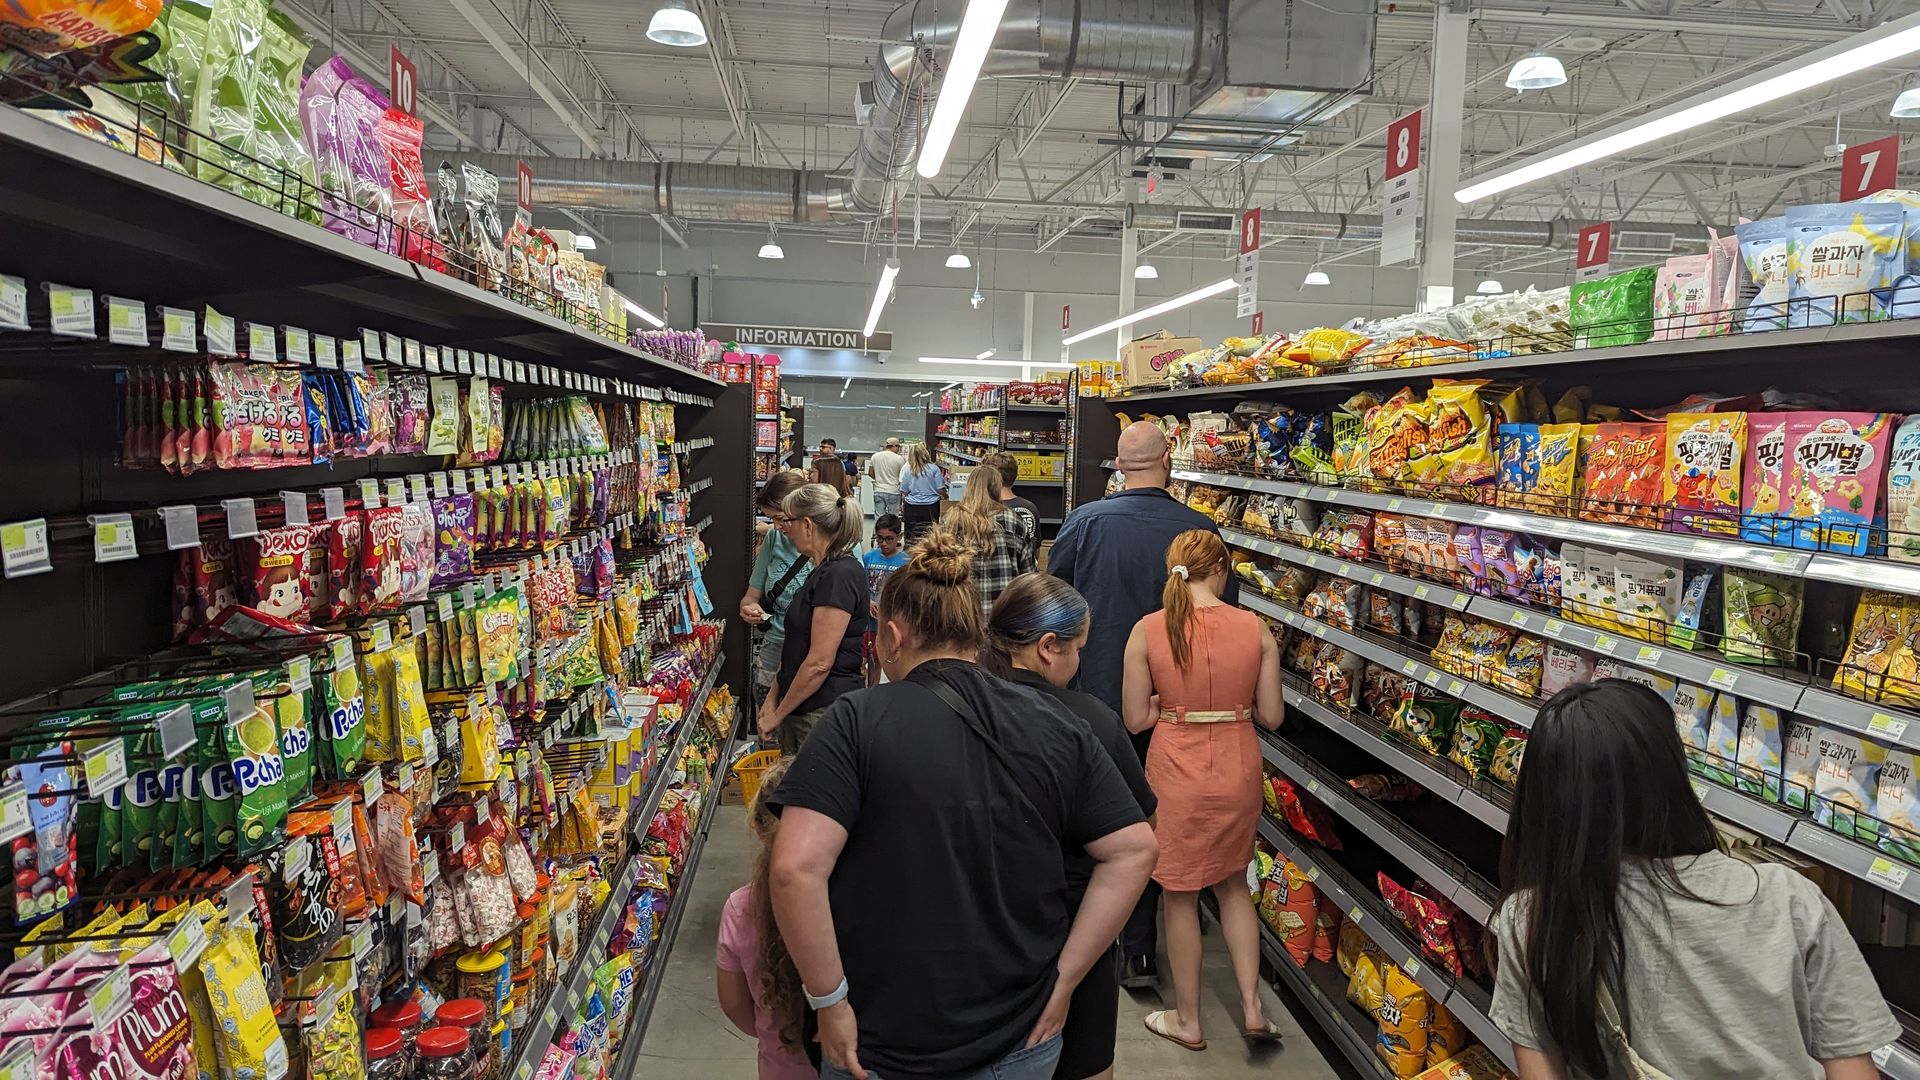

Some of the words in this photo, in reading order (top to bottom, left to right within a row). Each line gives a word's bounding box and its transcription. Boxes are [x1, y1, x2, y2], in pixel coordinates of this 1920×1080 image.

[396, 63, 412, 114] 10
[1396, 127, 1410, 168] 8
[1857, 150, 1881, 192] 7
[520, 170, 530, 205] 10
[1246, 217, 1254, 248] 8
[1586, 232, 1601, 262] 7
[1812, 244, 1865, 262] 쌀과자
[1810, 263, 1862, 281] 바나나
[735, 327, 858, 348] INFORMATION
[262, 556, 292, 568] SWEETS
[1627, 583, 1666, 597] 핑거퓨레
[284, 728, 308, 756] cha
[1819, 739, 1857, 764] 쌀과자
[1882, 759, 1910, 784] 쌀과자
[121, 990, 188, 1051] Plum
[153, 1029, 176, 1050] FLAVORED
[174, 1017, 188, 1036] CANDY
